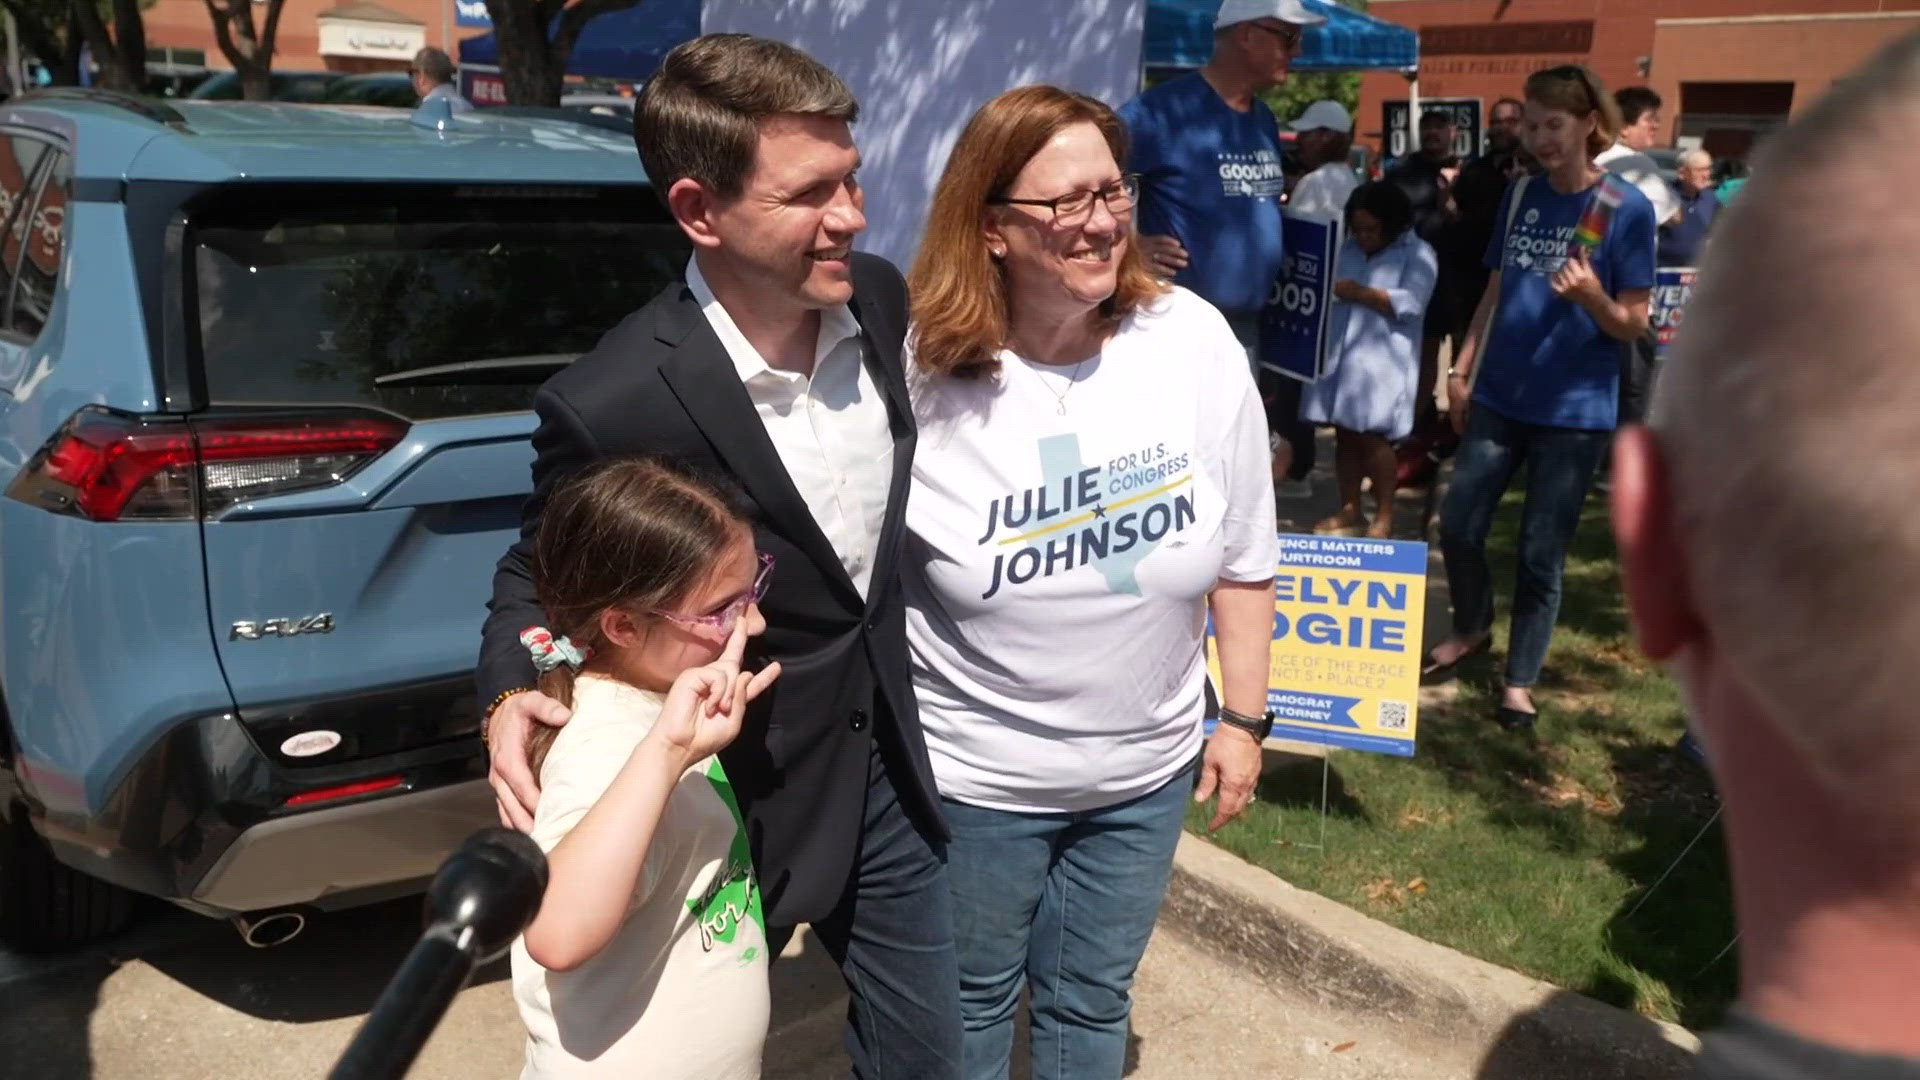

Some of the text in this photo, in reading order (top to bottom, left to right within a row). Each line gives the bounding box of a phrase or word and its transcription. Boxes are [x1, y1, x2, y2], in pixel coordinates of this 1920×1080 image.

[1109, 443, 1169, 476] FOR U.S.
[1109, 453, 1189, 495] CONGRESS
[978, 466, 1102, 545] JULIE
[982, 486, 1196, 600] JOHNSON
[1322, 540, 1395, 555] MATTERS
[1275, 574, 1407, 611] ELYN
[229, 612, 336, 642] RAV4
[1303, 655, 1322, 668] OF
[1328, 658, 1355, 673] THE
[1360, 661, 1408, 679] PEACE
[1327, 672, 1375, 688] PLACE
[1377, 678, 1386, 689] 2
[700, 900, 746, 952] for
